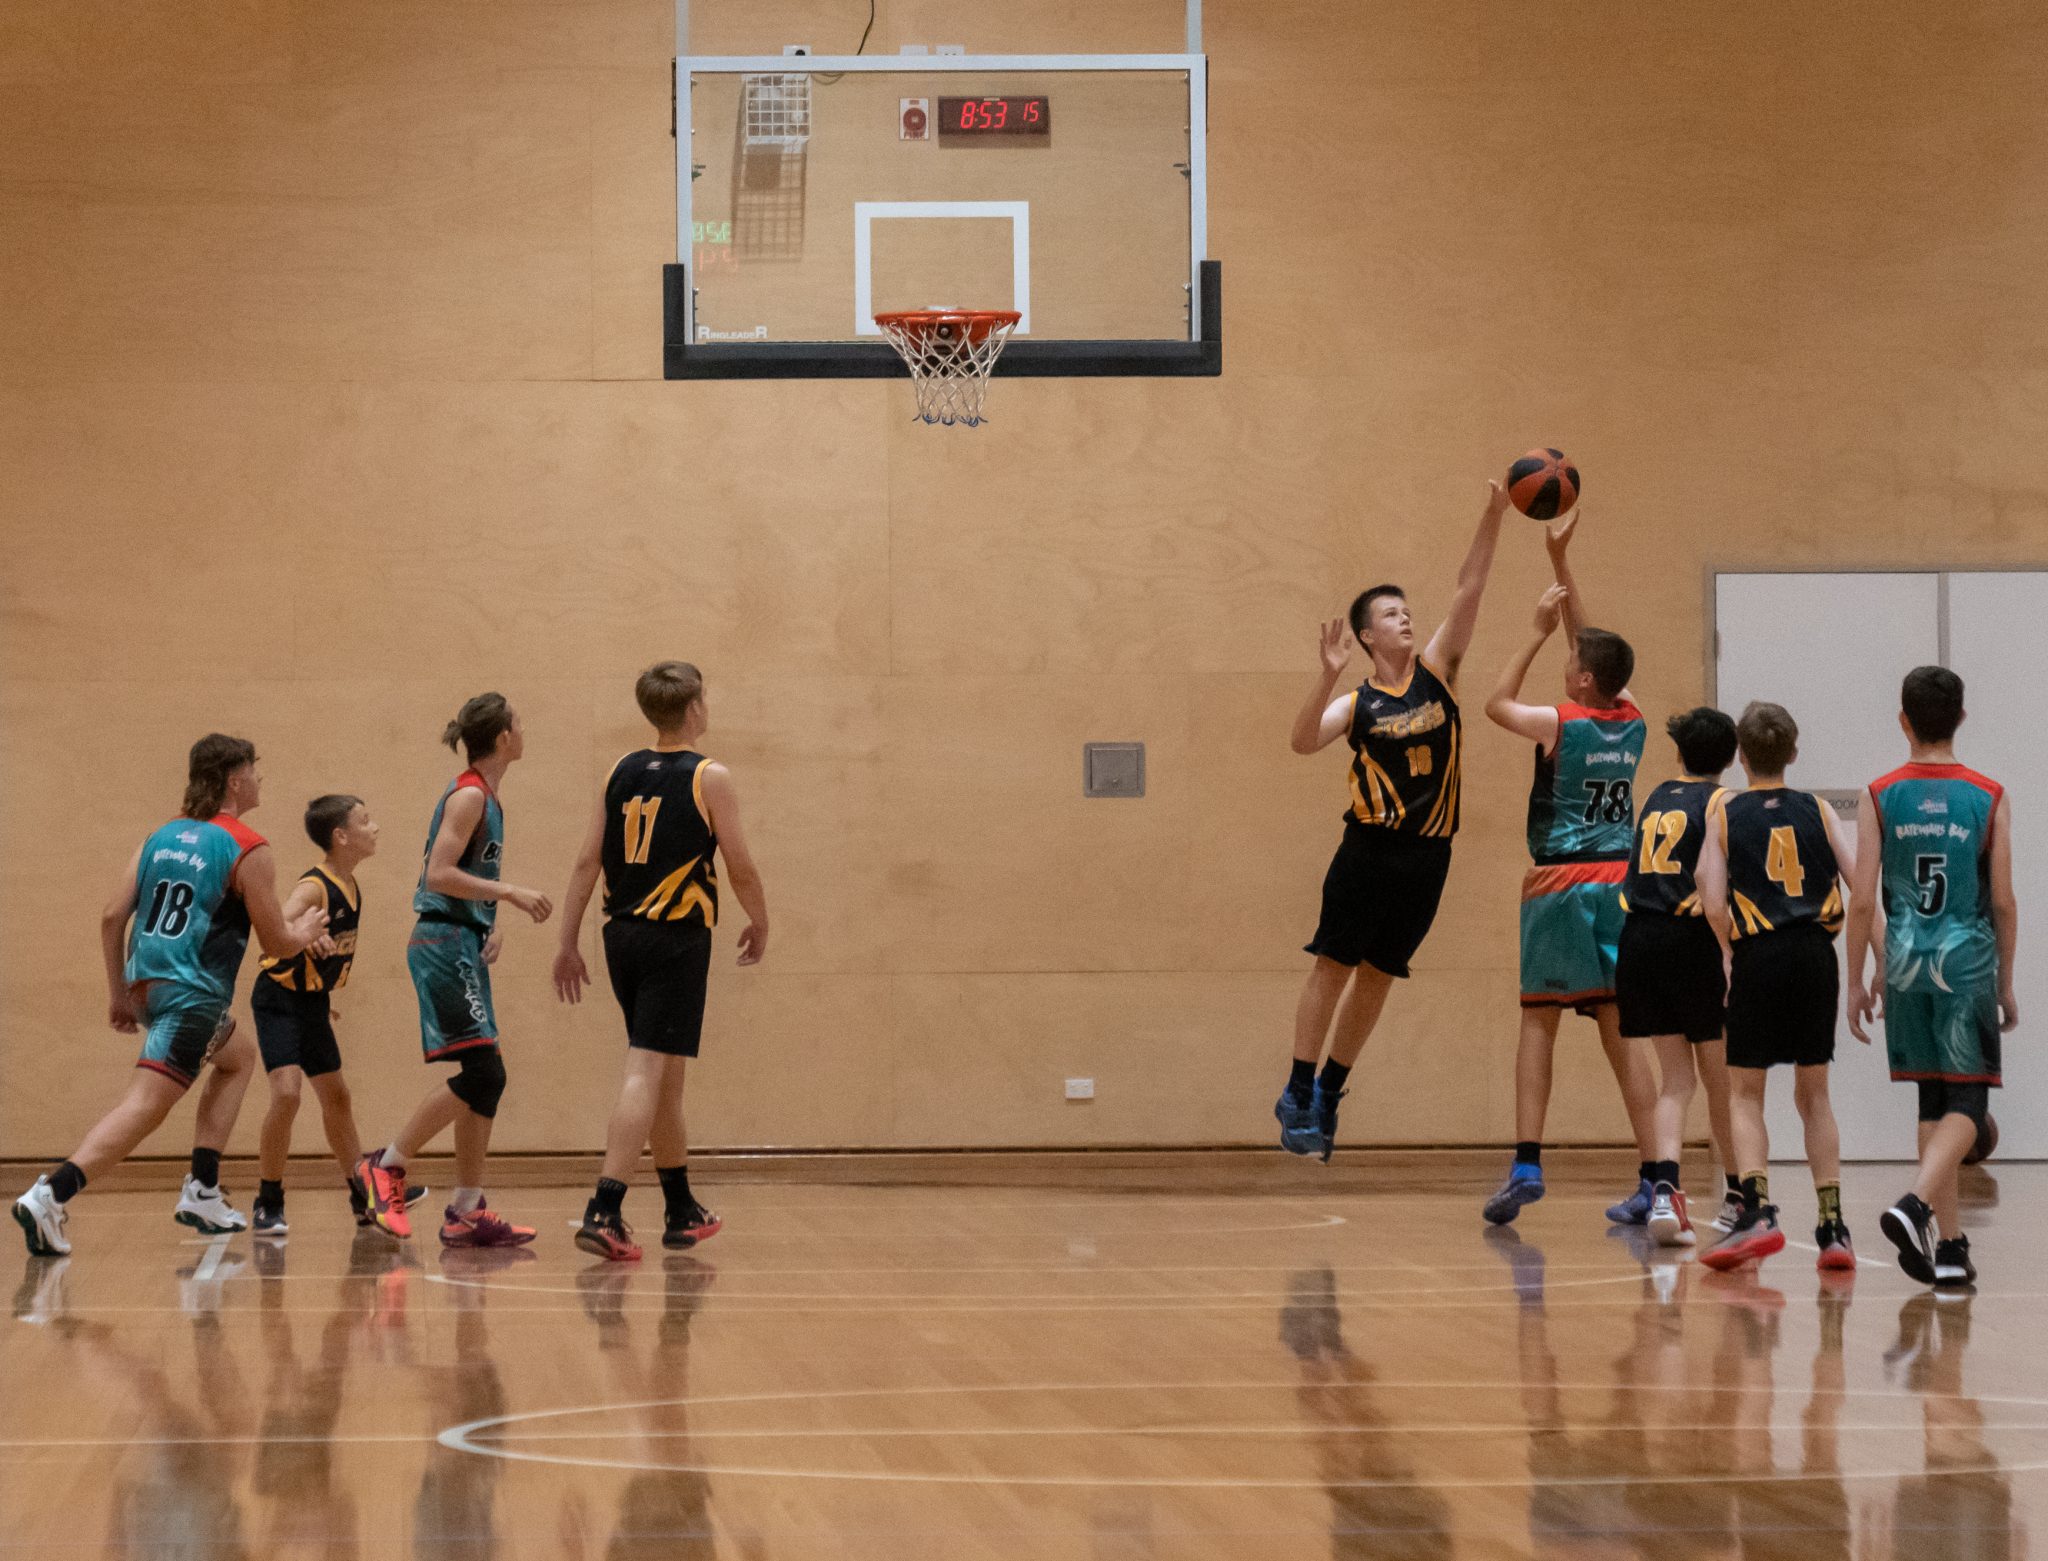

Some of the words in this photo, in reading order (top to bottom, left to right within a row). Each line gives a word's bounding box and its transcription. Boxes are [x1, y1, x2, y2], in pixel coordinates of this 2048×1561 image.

[960, 101, 1008, 129] 8:53
[1023, 101, 1039, 122] 15
[622, 795, 663, 864] 11
[1583, 778, 1632, 825] 78
[1638, 810, 1688, 875] 12
[1765, 825, 1805, 897] 4
[142, 879, 195, 939] 18
[1915, 854, 1948, 919] 5
